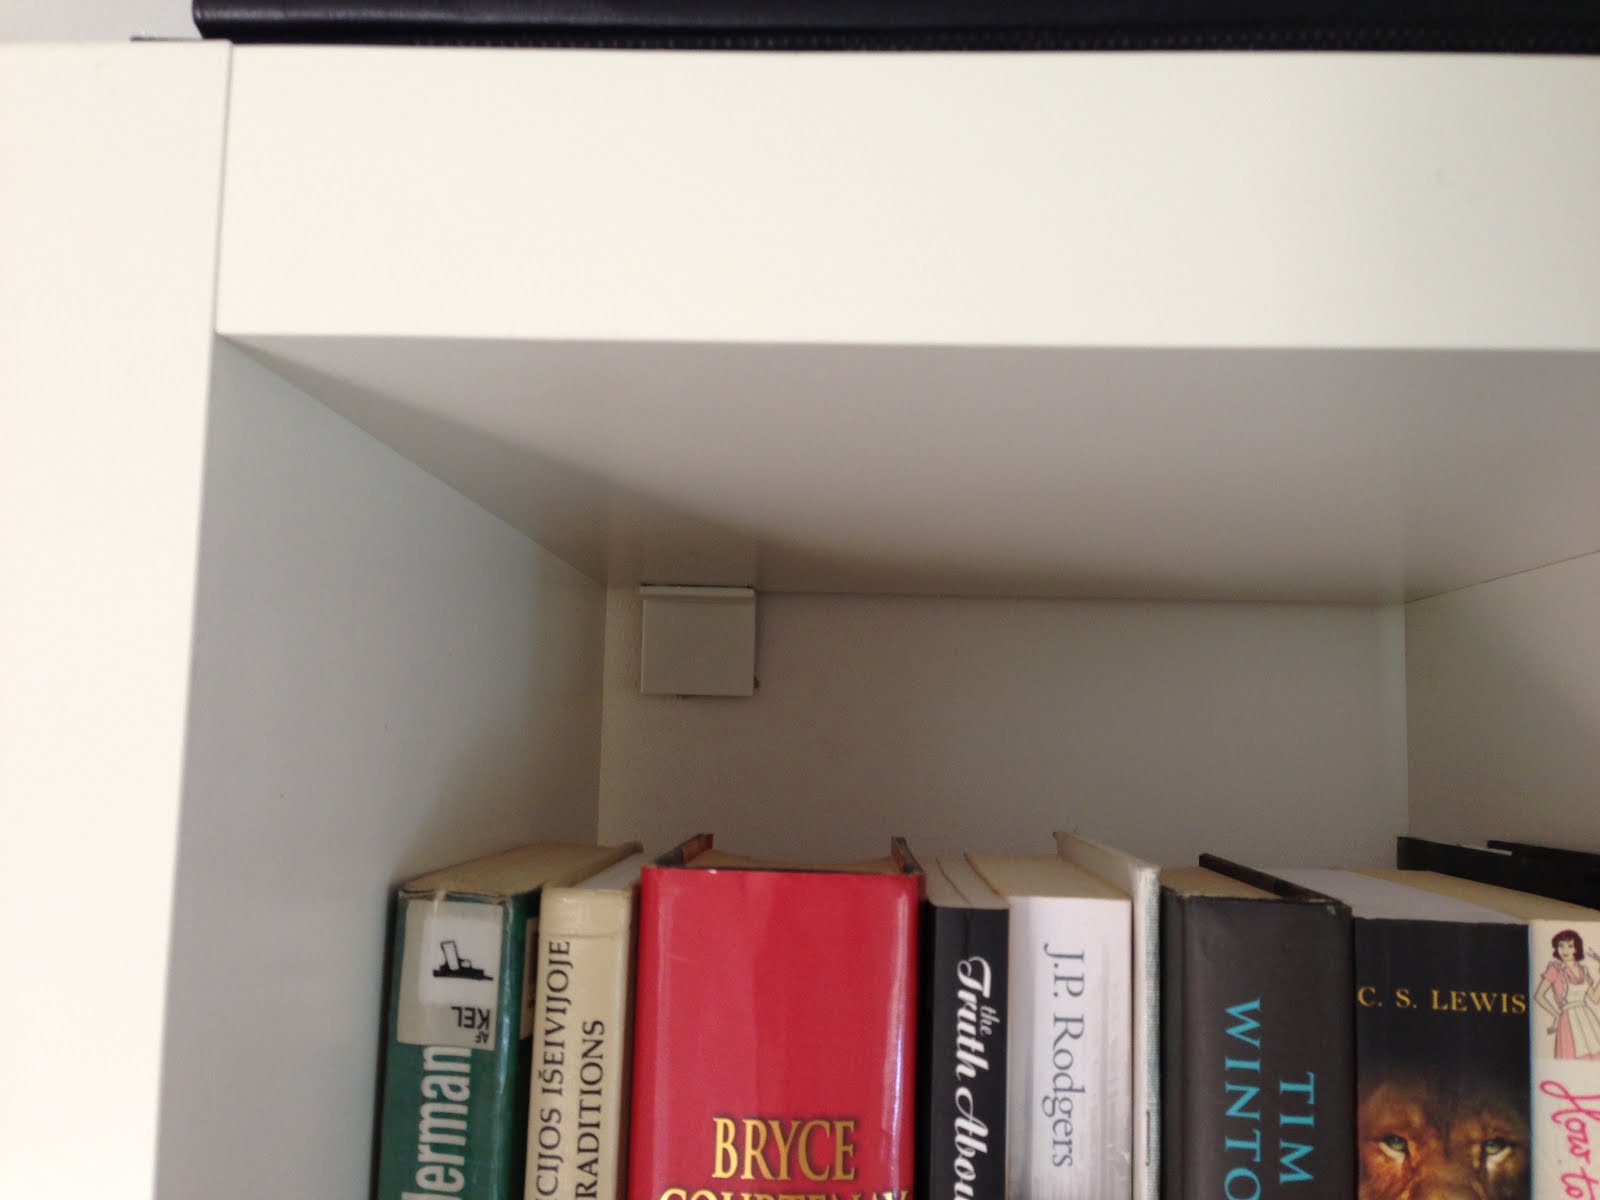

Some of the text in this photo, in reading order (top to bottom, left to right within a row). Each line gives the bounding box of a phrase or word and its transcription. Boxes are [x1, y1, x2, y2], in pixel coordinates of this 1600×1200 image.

[451, 1006, 491, 1030] KEL
[956, 956, 992, 1080] Truth
[979, 1005, 1001, 1036] the
[1042, 943, 1086, 1168] J.P. Rodgers
[1357, 986, 1528, 1015] C. S. LEWIS
[536, 940, 574, 1200] CIJOS IŠEIVIJOJE
[576, 1019, 605, 1200] RADITIONS
[1224, 998, 1262, 1200] WINTO
[1539, 1080, 1600, 1165] How
[711, 1117, 856, 1182] BRYCE
[1279, 1071, 1315, 1185] TIM
